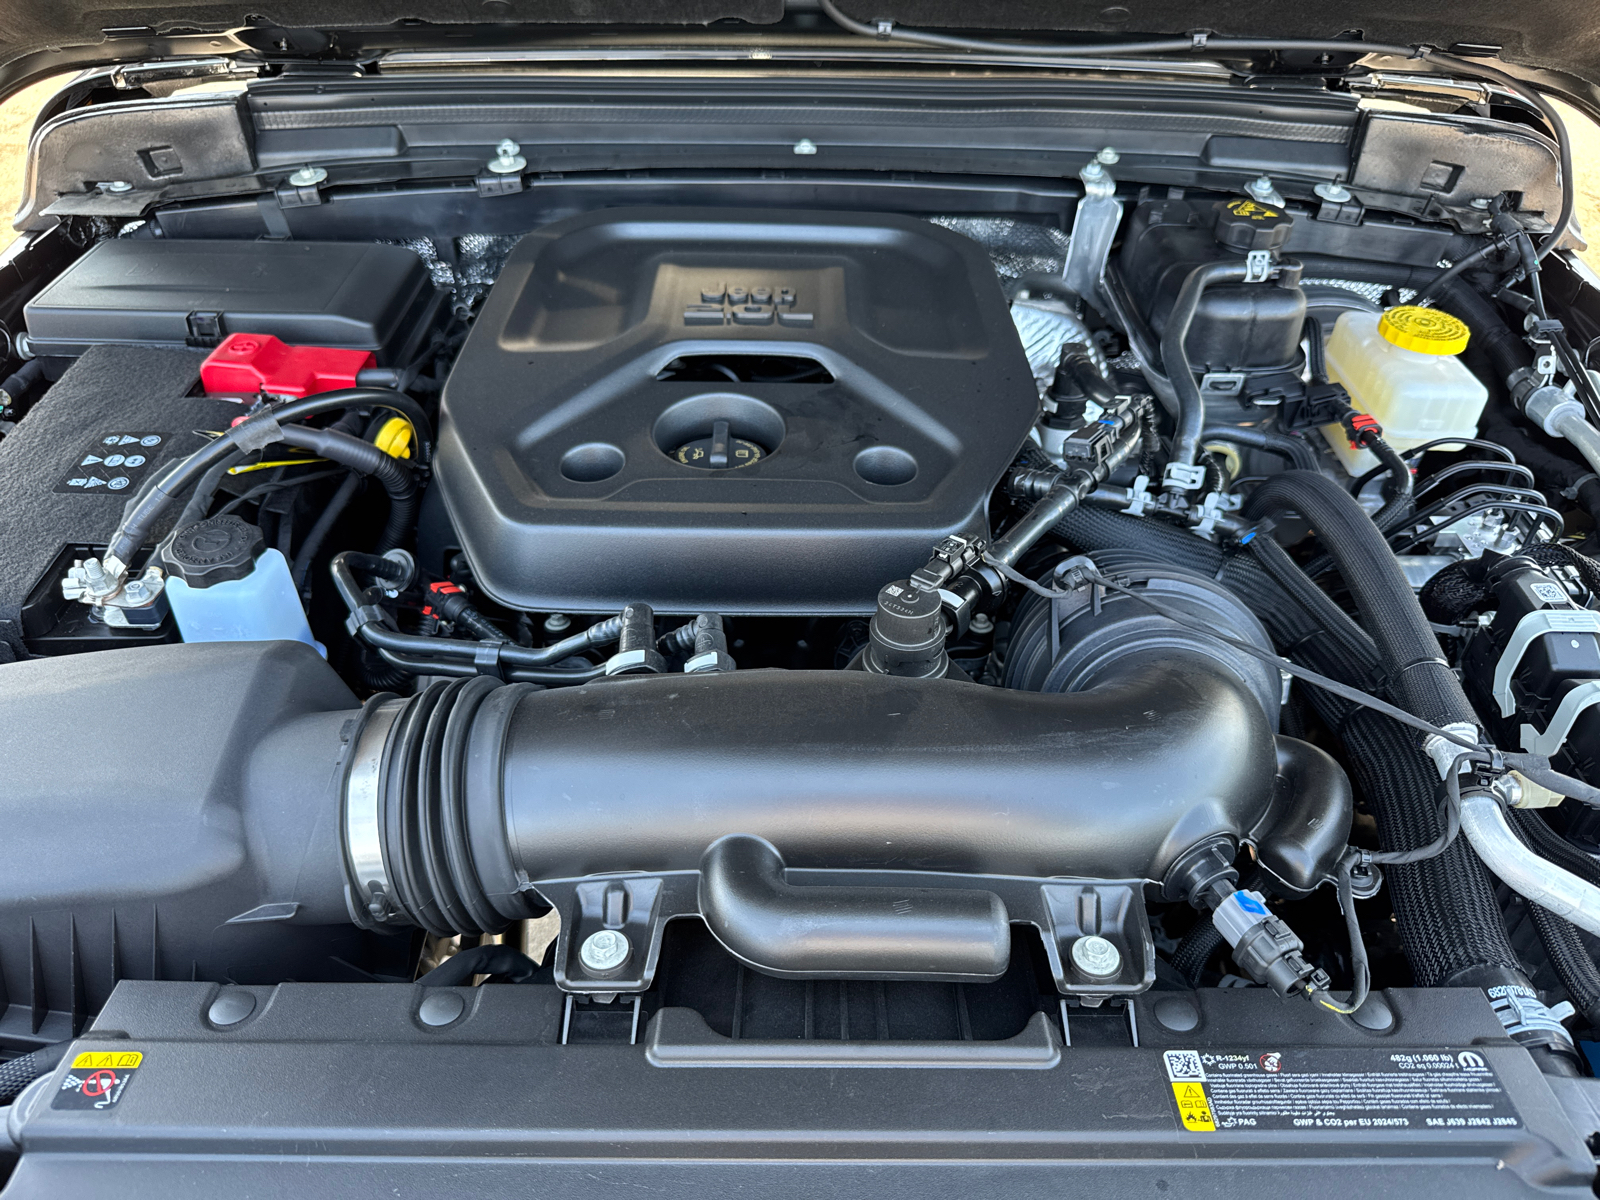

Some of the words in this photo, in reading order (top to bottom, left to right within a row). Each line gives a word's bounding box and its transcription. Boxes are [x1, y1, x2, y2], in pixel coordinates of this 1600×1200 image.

[701, 283, 797, 307] Jeep
[1390, 1054, 1413, 1063] 482g
[1413, 1054, 1440, 1063] (1.060
[1441, 1054, 1453, 1063] lb)
[1237, 1118, 1257, 1126] PAG
[1293, 1118, 1314, 1126] GWP
[1315, 1118, 1323, 1126] &
[1324, 1118, 1342, 1126] CO2
[1343, 1119, 1357, 1127] per
[1358, 1118, 1371, 1126] EU
[1426, 1118, 1445, 1126] SAE
